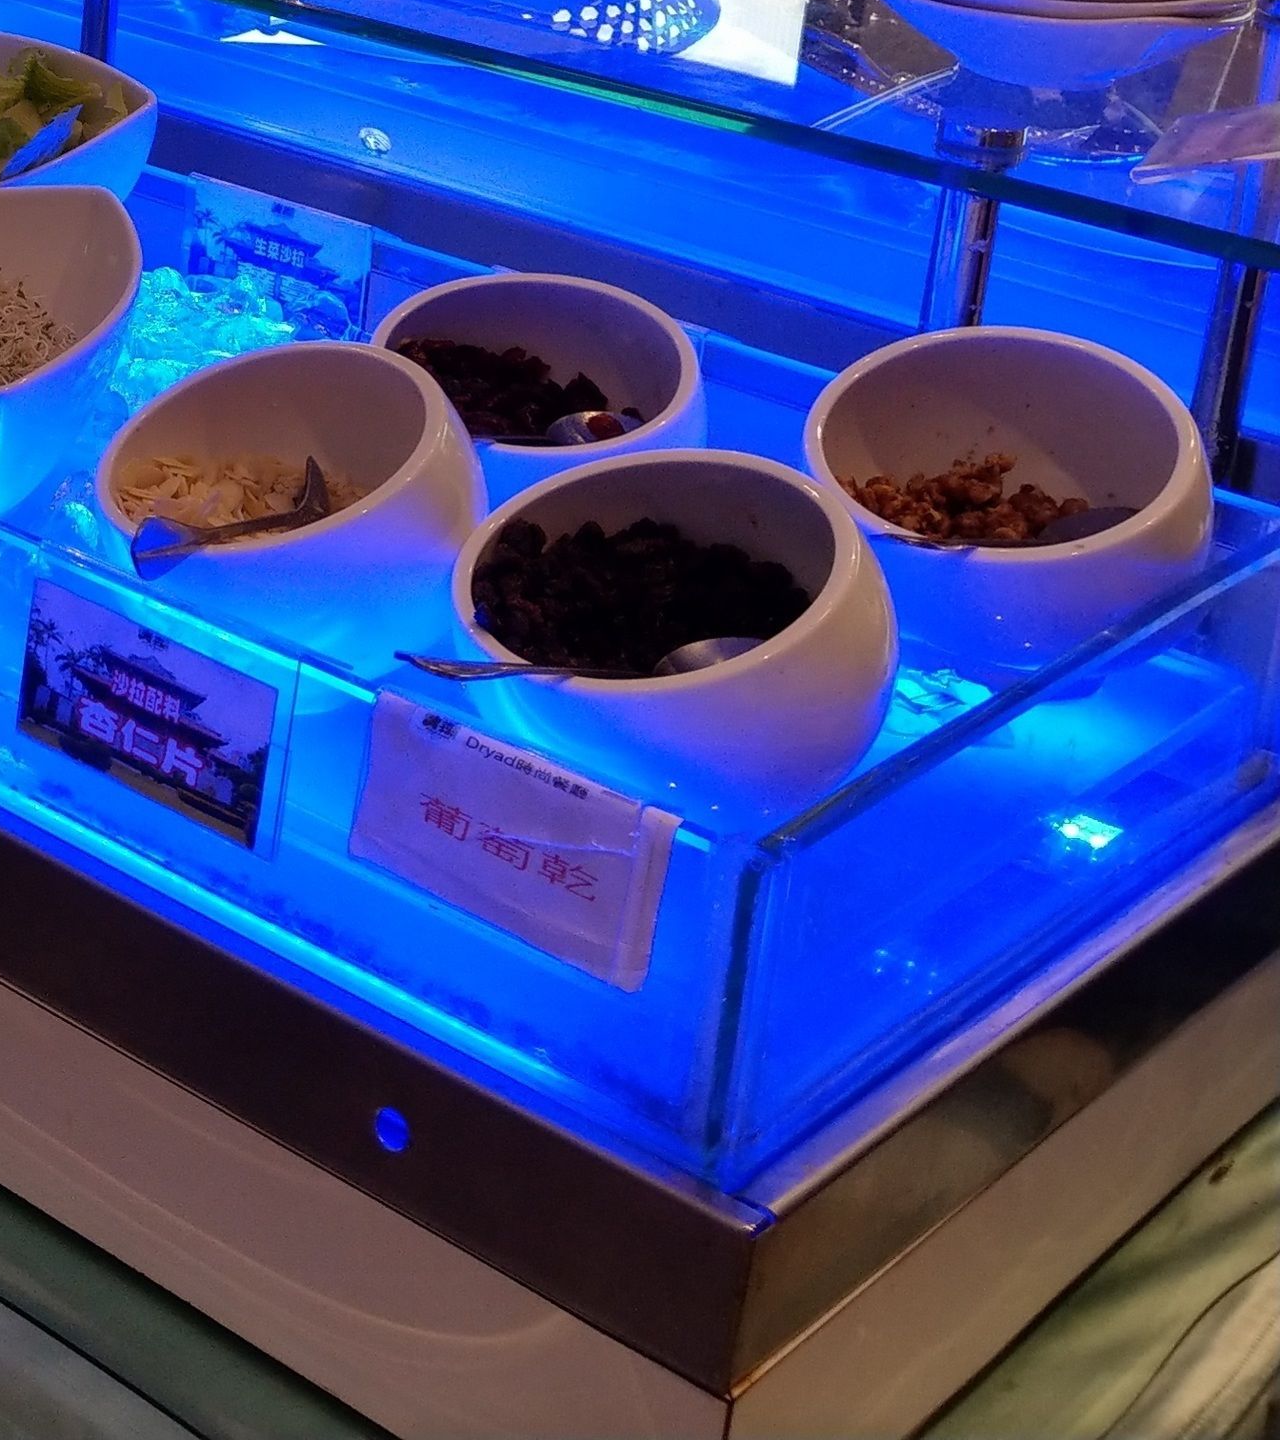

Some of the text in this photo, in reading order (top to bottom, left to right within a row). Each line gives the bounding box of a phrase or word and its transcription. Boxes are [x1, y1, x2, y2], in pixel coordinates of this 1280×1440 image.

[254, 237, 306, 268] 生菜沙拉
[111, 670, 180, 723] 沙拉配料
[78, 697, 204, 786] 杏仁片
[419, 791, 600, 902] 葡萄乾
